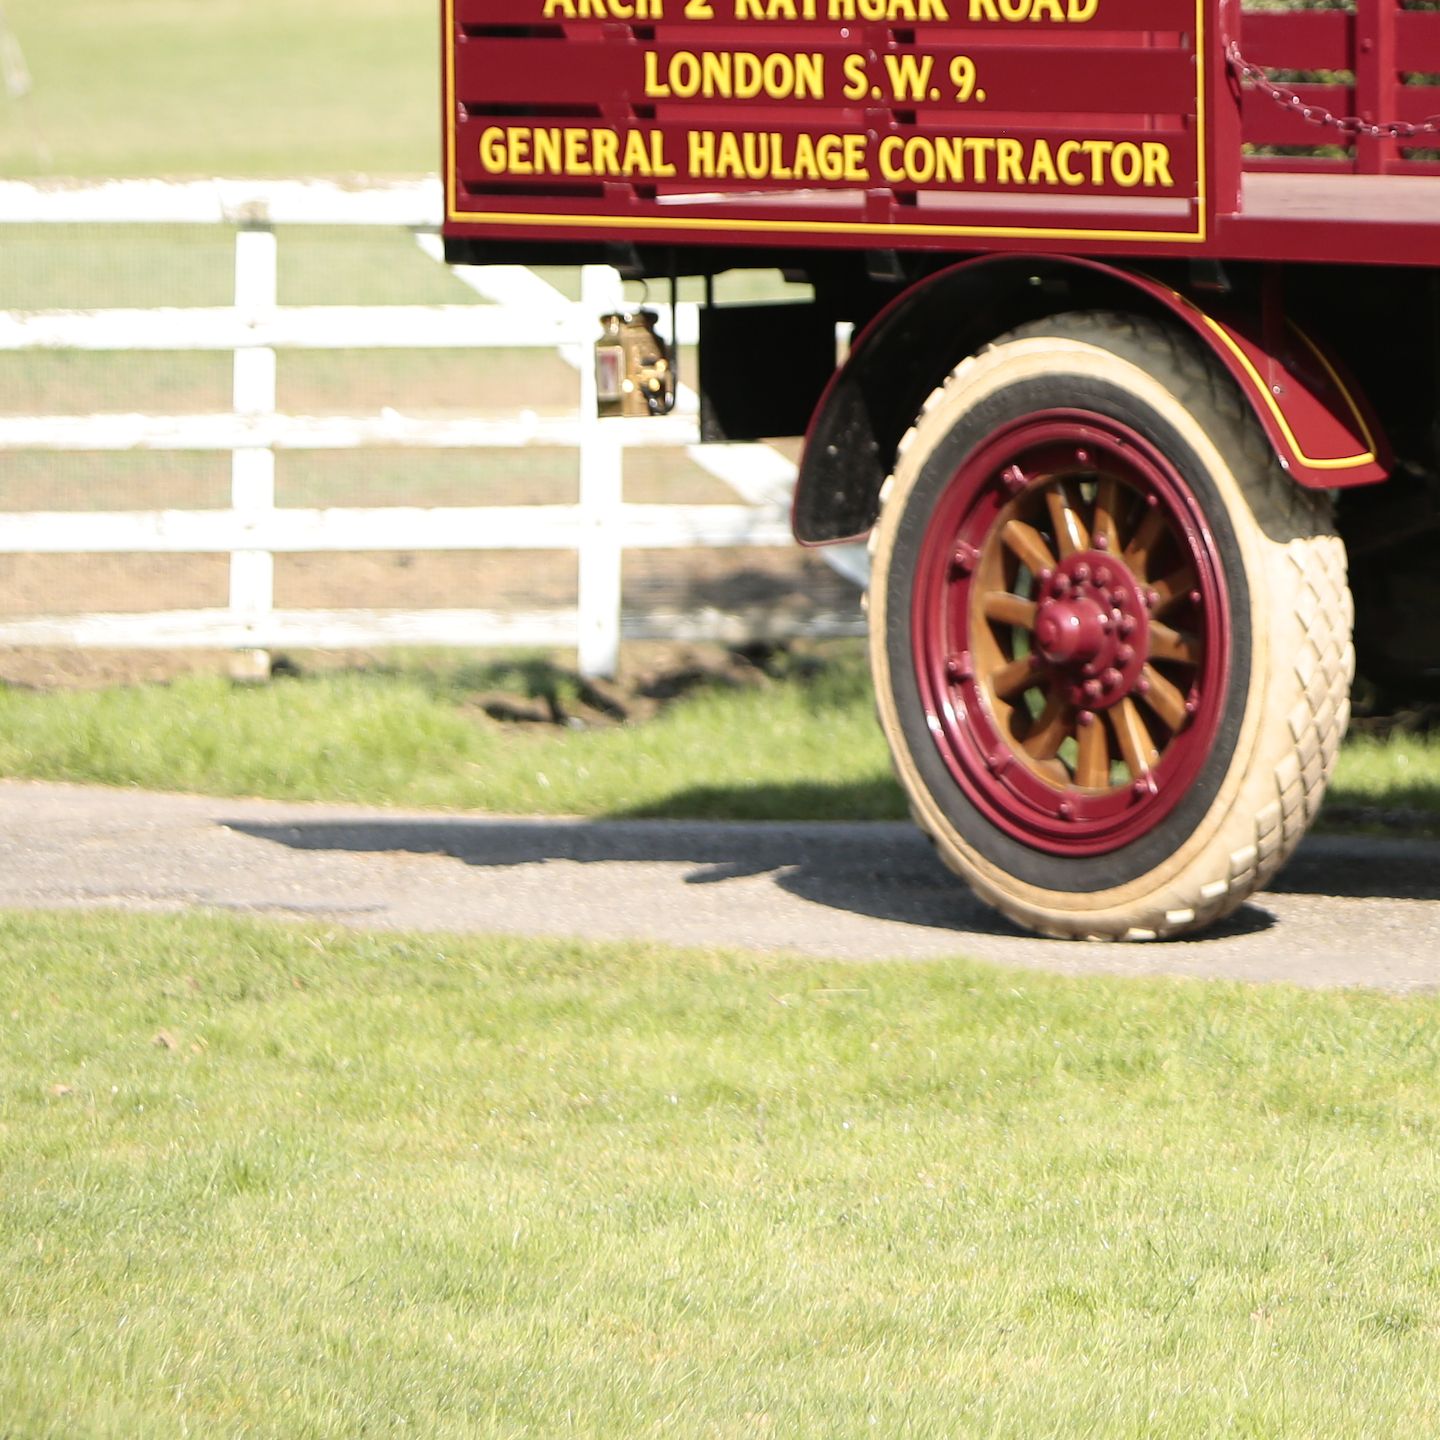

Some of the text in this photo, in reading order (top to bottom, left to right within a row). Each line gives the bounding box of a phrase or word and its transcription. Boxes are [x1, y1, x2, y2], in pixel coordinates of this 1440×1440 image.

[644, 51, 824, 100] LONDON
[479, 126, 1174, 188] GENERAL HAULAGE CONTRACTOR
